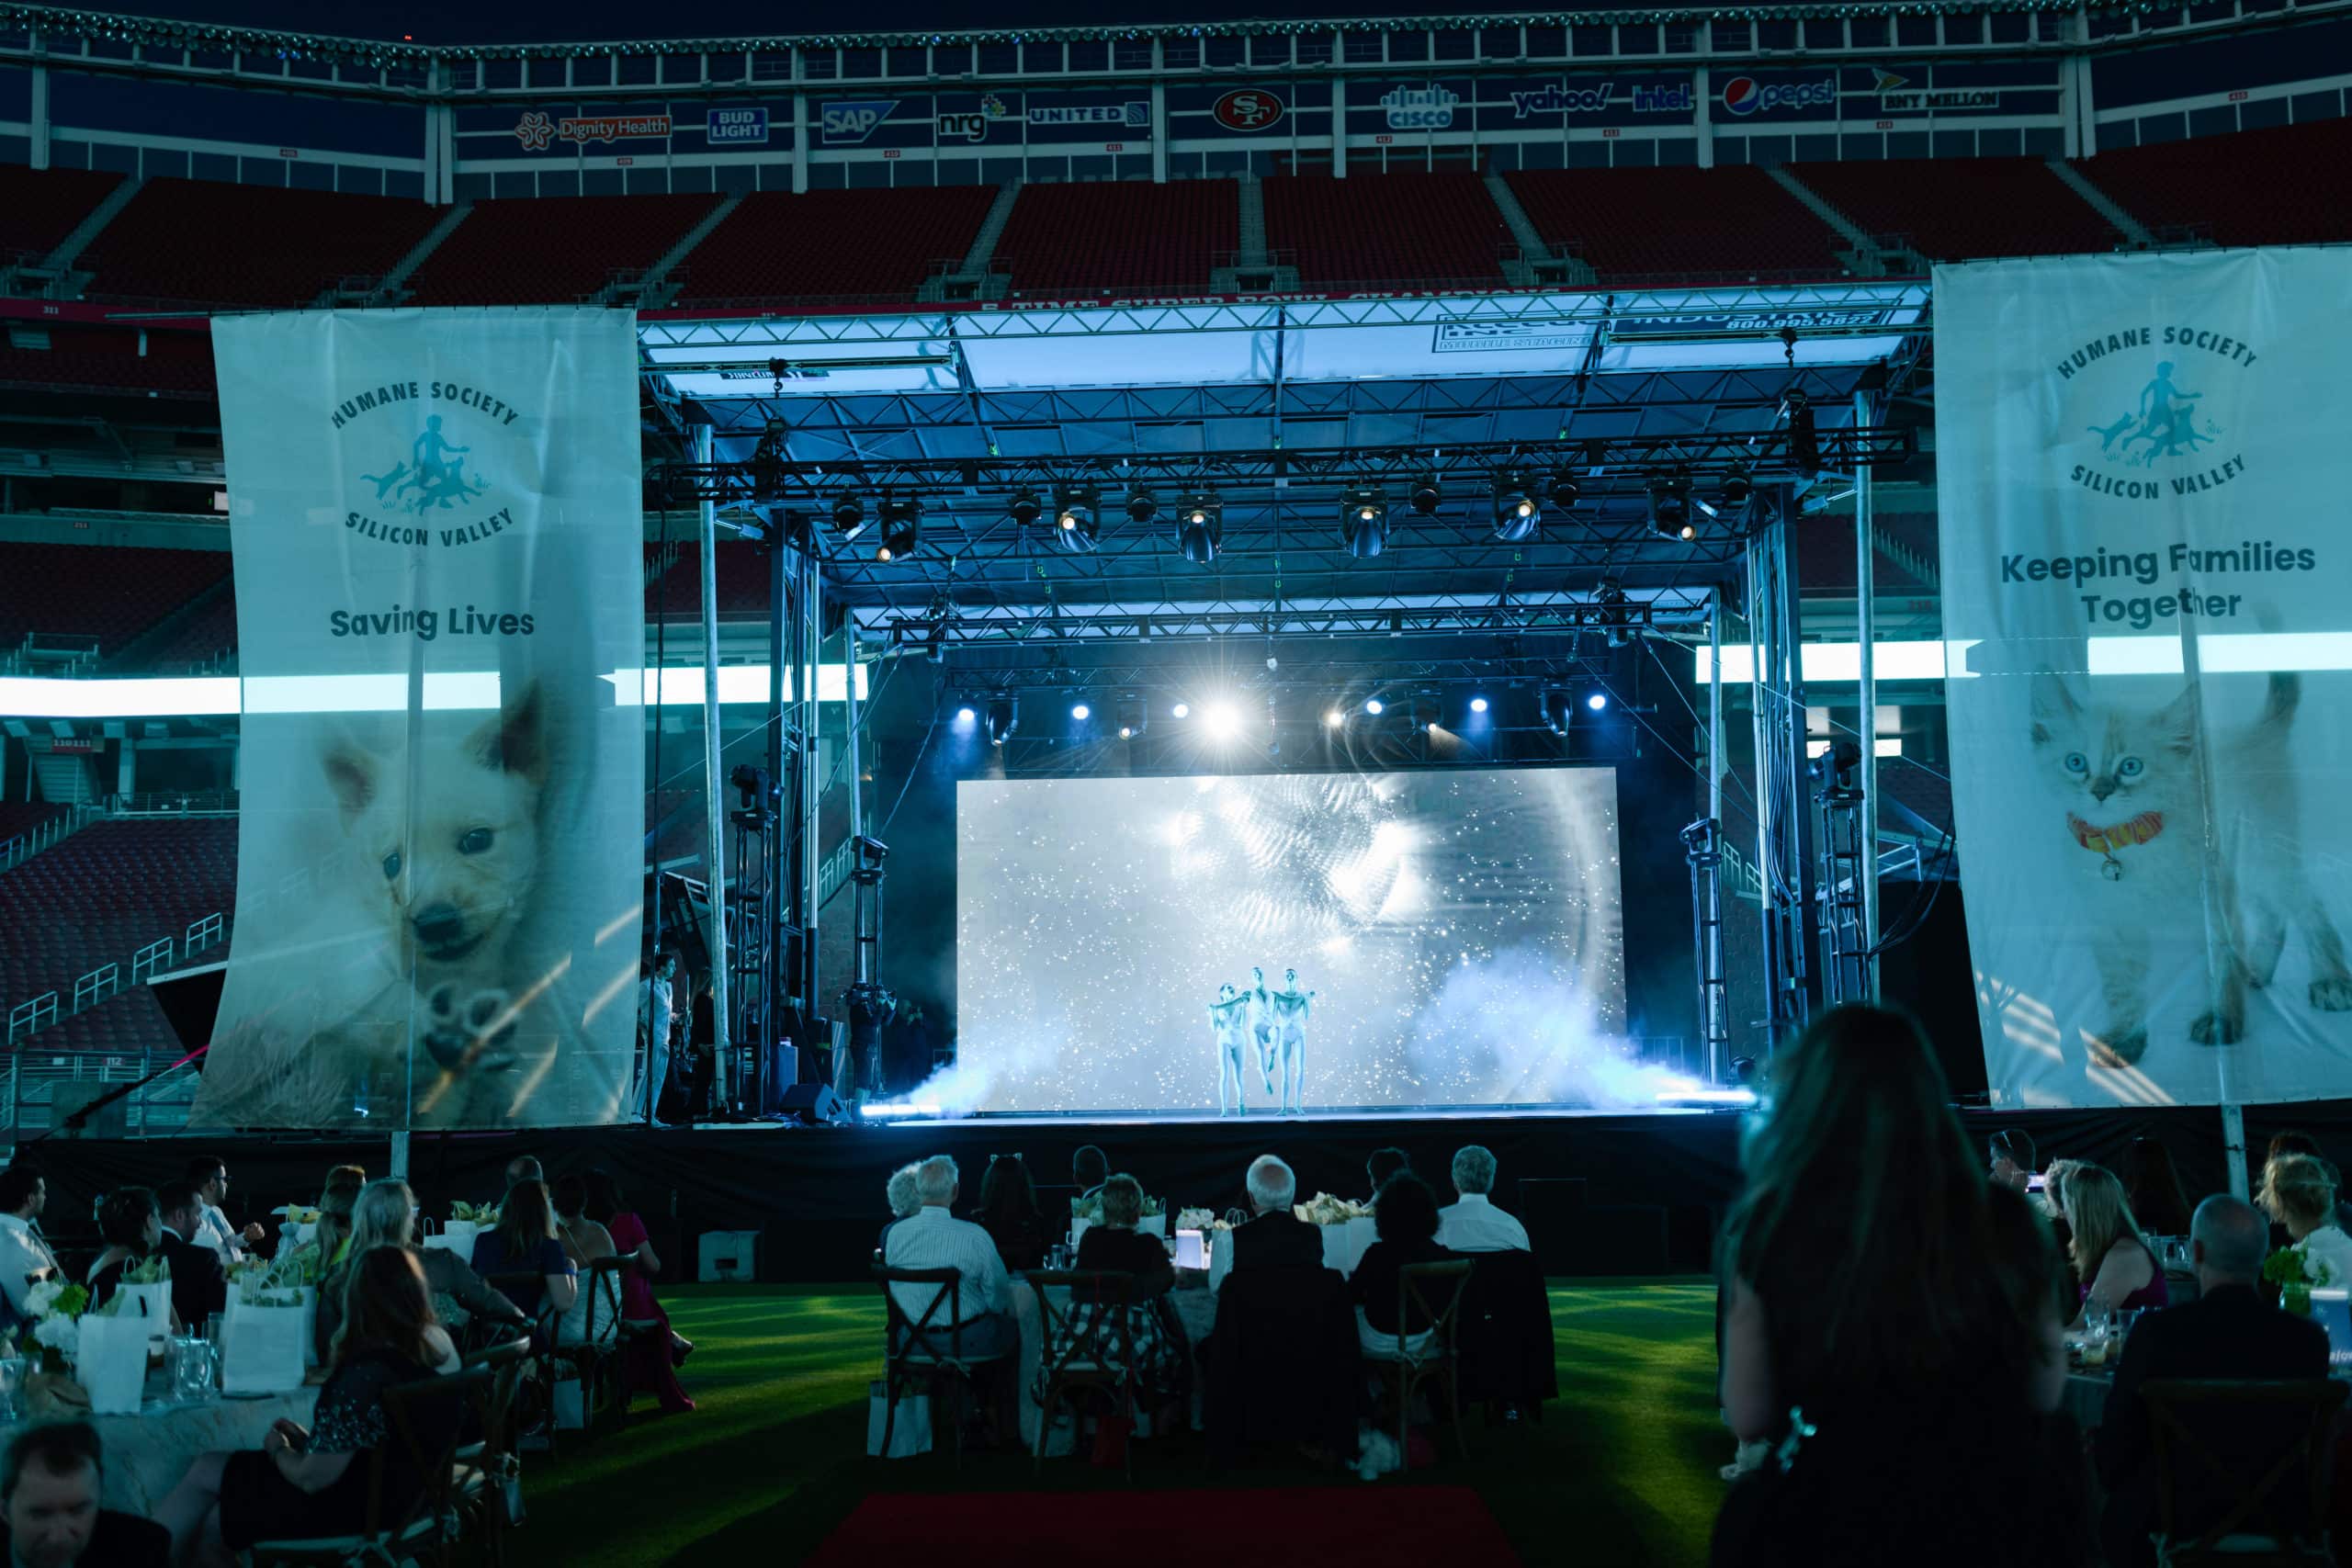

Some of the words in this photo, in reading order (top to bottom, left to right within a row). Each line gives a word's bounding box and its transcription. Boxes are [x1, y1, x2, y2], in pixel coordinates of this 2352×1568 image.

[1513, 83, 1614, 118] yahoo!
[1761, 78, 1834, 110] pepsi
[1884, 94, 1921, 108] BNY
[1924, 91, 1997, 107] MELLON
[560, 118, 616, 142] Dignity
[618, 117, 668, 135] Health
[712, 124, 763, 139] LIGHT
[718, 111, 755, 125] BUD
[824, 108, 877, 134] SAP
[939, 112, 987, 141] nrg
[1030, 107, 1123, 123] UNITED
[2057, 327, 2152, 380] HUMANE
[2163, 326, 2257, 368] SOCIETY
[330, 381, 420, 430] HUMANE
[430, 381, 519, 426] SOCIETY
[2070, 464, 2159, 500] SILICON
[2171, 454, 2245, 496] VALLEY
[345, 511, 429, 546] SILICON
[439, 507, 513, 547] VALLEY
[2001, 547, 2158, 589] Keeping
[2168, 540, 2316, 573] Families
[330, 604, 438, 641] Saving
[448, 604, 535, 636] Lives
[2081, 587, 2242, 630] Together
